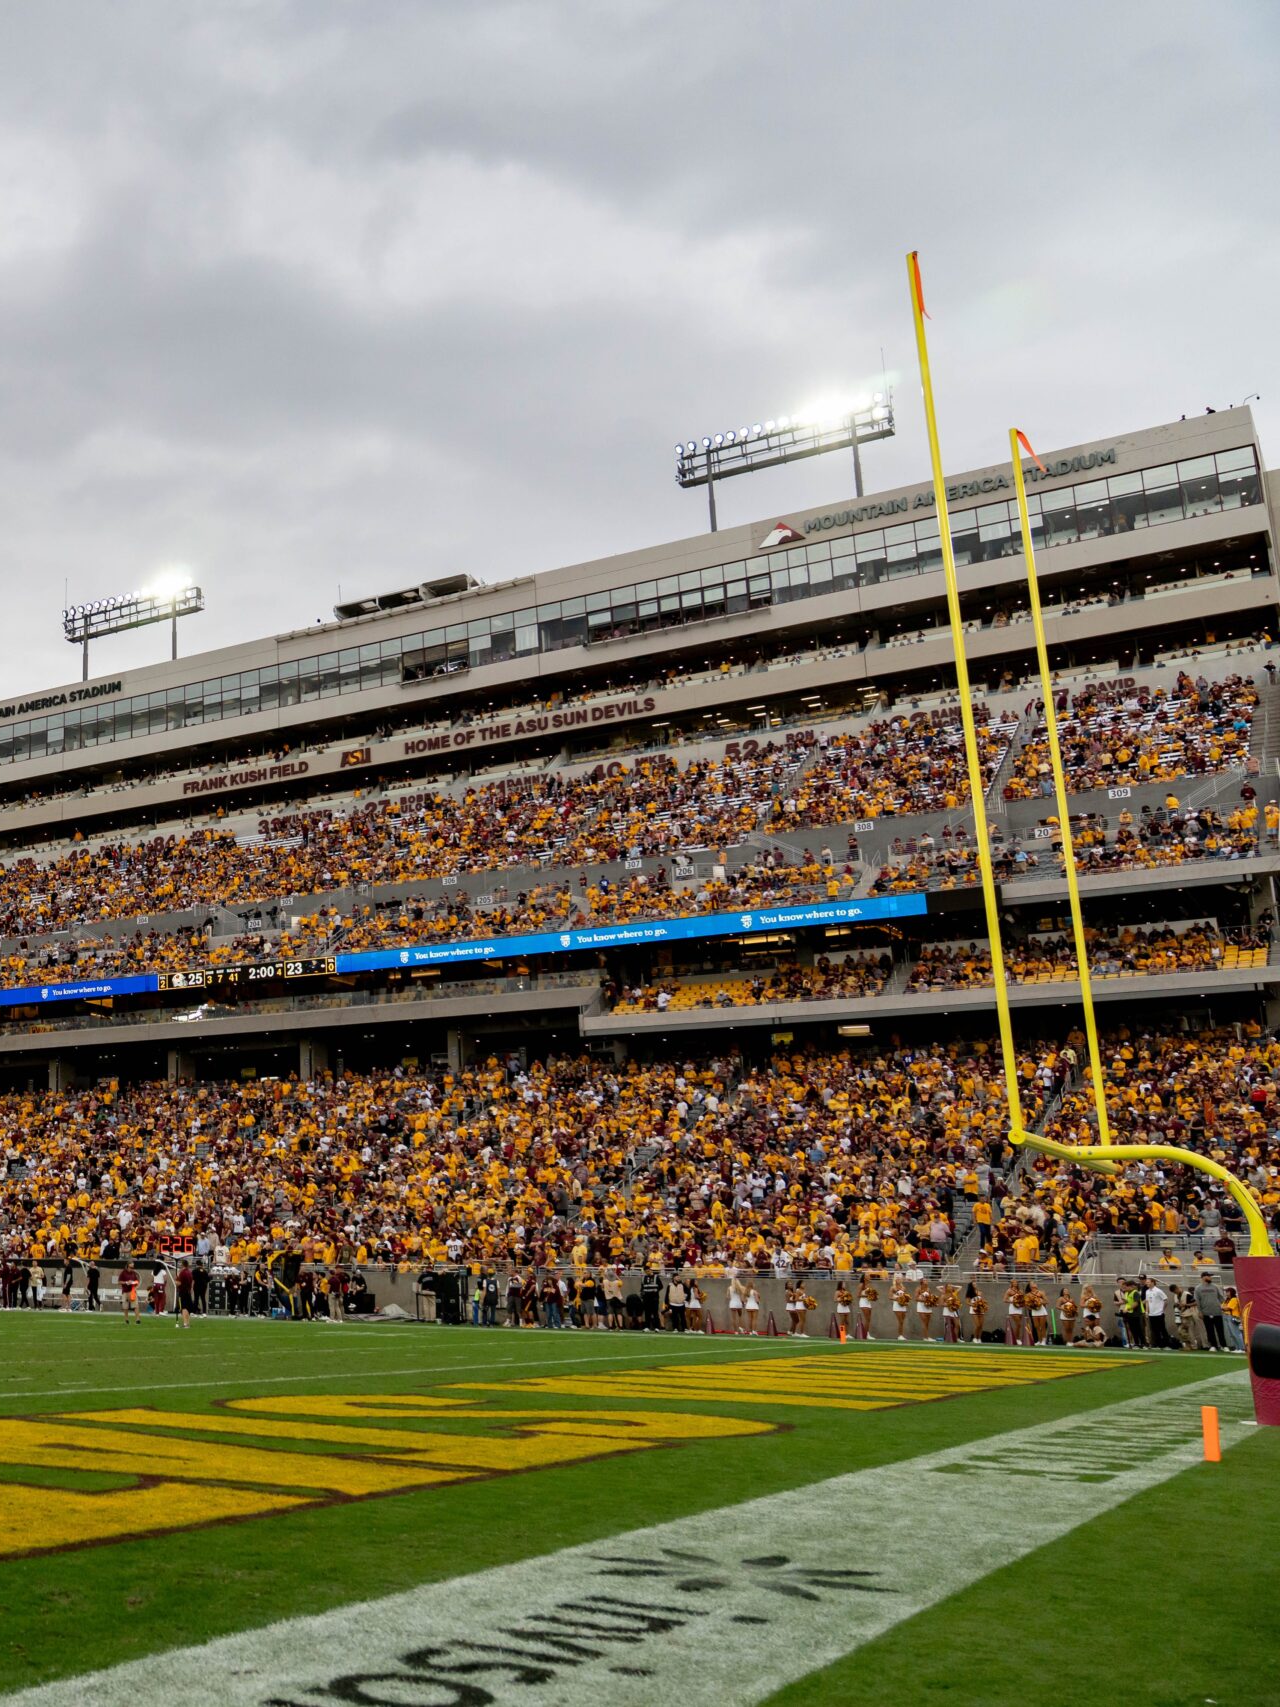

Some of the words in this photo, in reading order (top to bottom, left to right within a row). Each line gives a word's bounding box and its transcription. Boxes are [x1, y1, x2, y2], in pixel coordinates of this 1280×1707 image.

[803, 497, 908, 534] MOUNTAIN
[1013, 448, 1116, 486] TADIUM
[1085, 678, 1136, 695] DAVID
[17, 693, 67, 714] AMERICA
[69, 681, 122, 703] STADIUM
[404, 734, 451, 755] HOME
[453, 730, 475, 746] OF
[478, 723, 511, 741] THE
[514, 716, 548, 735] ASU
[552, 709, 587, 728] SUN
[591, 698, 656, 722] DEVILS
[340, 747, 372, 768] ASU
[725, 740, 759, 761] 52
[183, 775, 228, 794] FRANK
[230, 768, 267, 787] KUSH
[269, 761, 309, 779] FIELD
[1110, 789, 1129, 798] 309
[856, 823, 873, 831] 308
[626, 860, 641, 869] 307
[678, 867, 693, 876] 206
[443, 878, 456, 886] 306
[479, 896, 492, 904] 205
[759, 914, 777, 924] You
[778, 913, 804, 923] know
[805, 911, 834, 921] where
[835, 909, 846, 918] to
[847, 908, 863, 918] go.
[249, 921, 261, 929] 204
[576, 935, 592, 944] You
[593, 933, 616, 942] know
[617, 930, 643, 940] where
[644, 929, 653, 937] to
[654, 928, 668, 938] go.
[414, 952, 428, 960] You
[429, 951, 447, 959] know
[448, 948, 473, 957] where
[482, 946, 496, 955] go.
[248, 966, 274, 980] 2:00
[276, 968, 282, 976] 4
[286, 962, 303, 976] 23
[328, 963, 334, 972] 0
[188, 972, 203, 986] 25
[206, 976, 212, 984] 3
[218, 974, 223, 983] 7
[228, 972, 239, 982] 41
[160, 1236, 193, 1253] 2:26
[776, 1260, 786, 1268] 42
